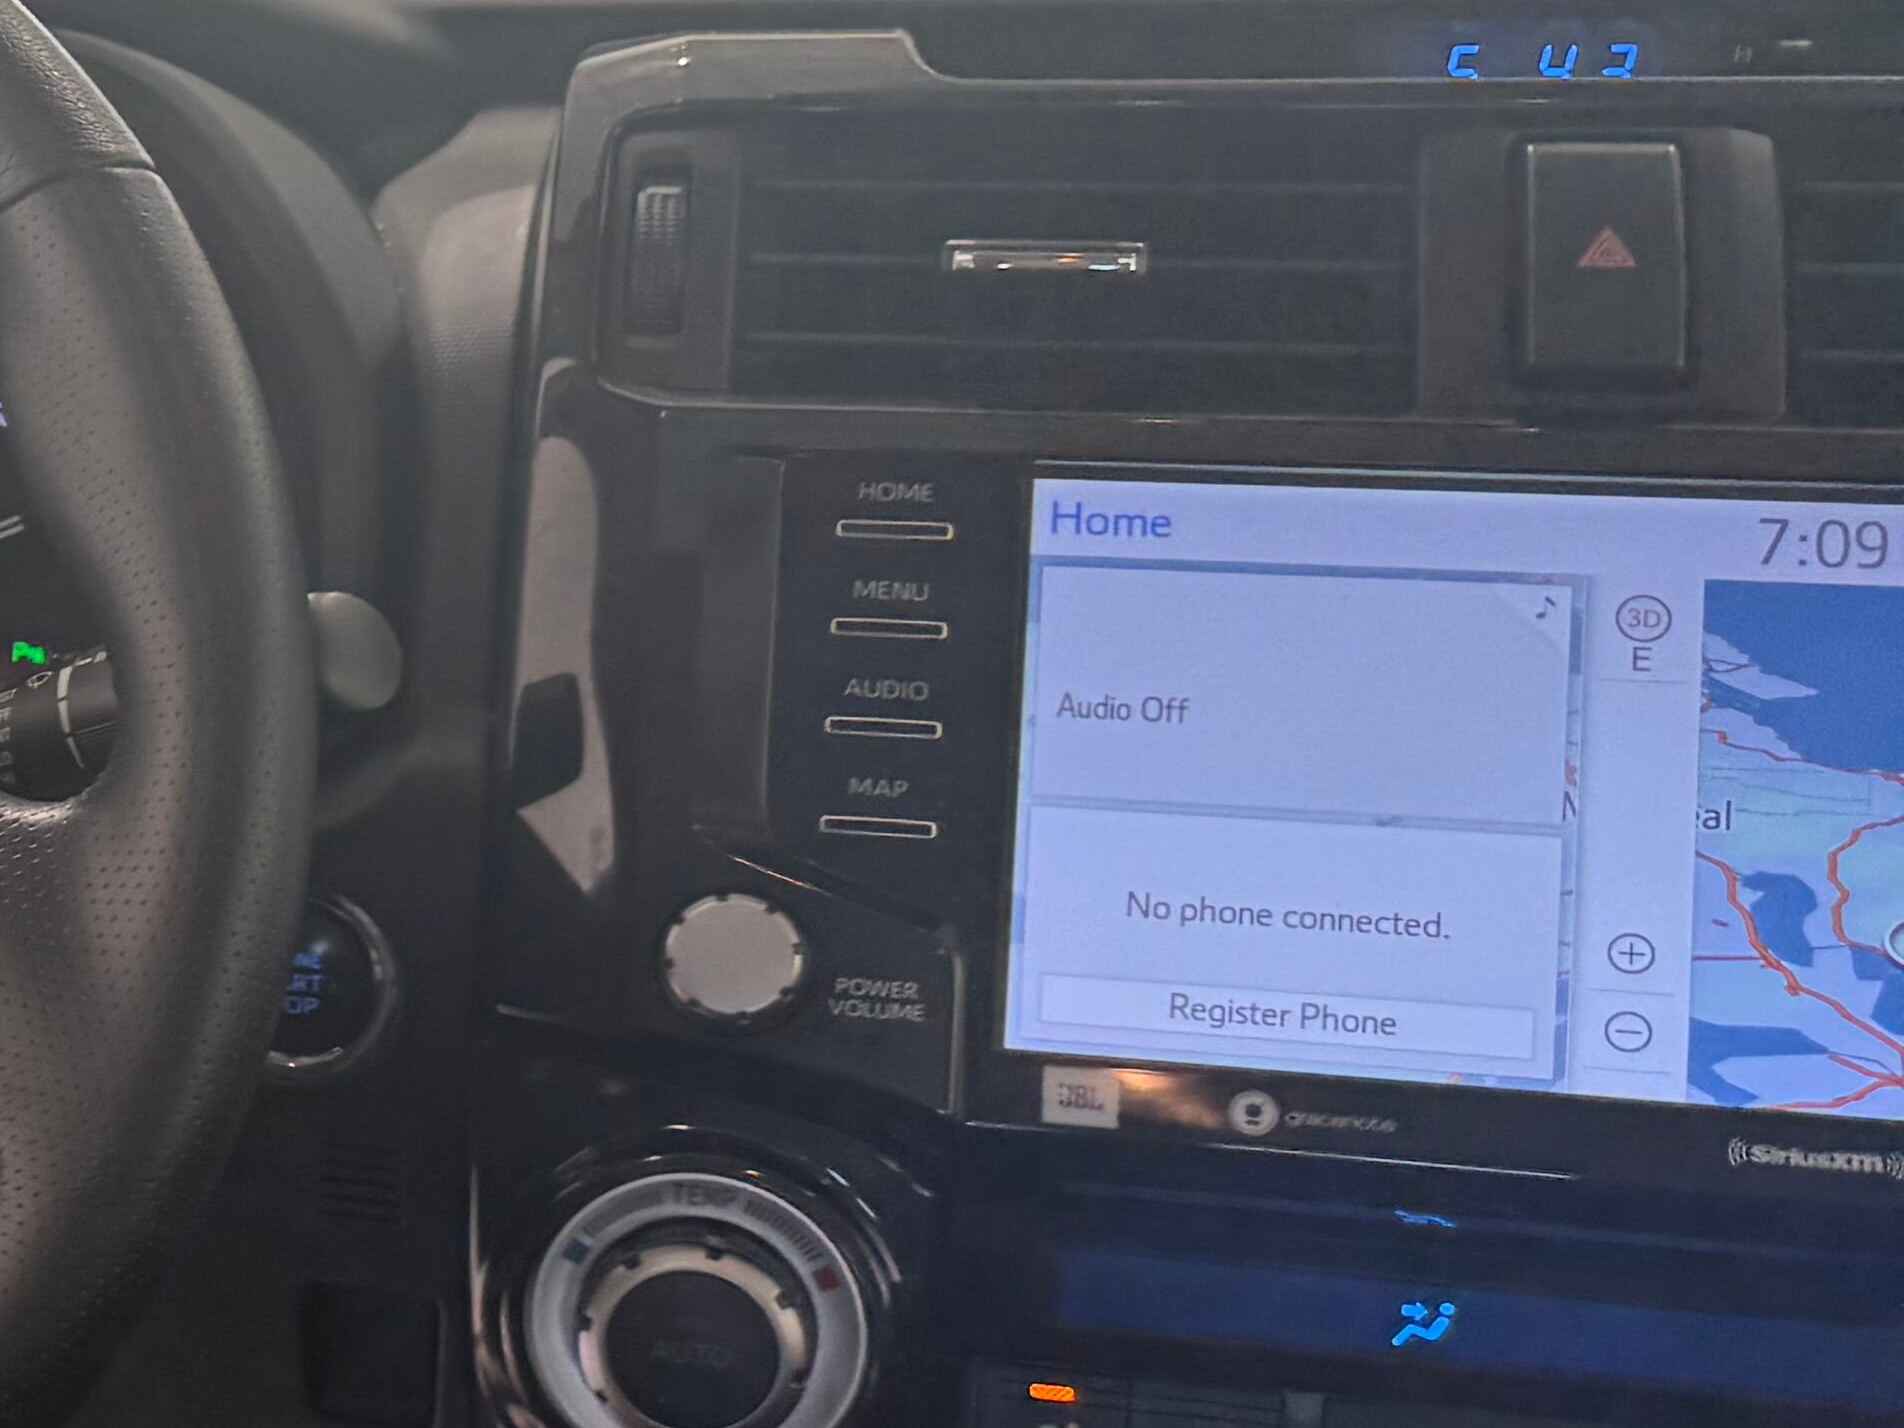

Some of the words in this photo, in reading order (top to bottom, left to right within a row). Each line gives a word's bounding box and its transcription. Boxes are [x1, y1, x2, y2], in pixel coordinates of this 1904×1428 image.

[857, 481, 935, 504] HOME
[1049, 500, 1173, 540] Home
[1757, 517, 1890, 570] 7:09
[852, 579, 930, 603] MENU
[1626, 607, 1662, 630] 3D
[1631, 645, 1654, 673] E
[843, 677, 930, 702] AUDIO
[1055, 690, 1132, 723] Audio
[1140, 695, 1191, 725] Off
[846, 777, 910, 799] MAP
[1695, 799, 1733, 832] al
[1125, 890, 1172, 921] No
[1179, 895, 1274, 930] phone
[1282, 904, 1451, 941] connected.
[833, 977, 920, 1001] POWER
[827, 998, 928, 1025] VOLUME
[1167, 991, 1293, 1031] Register
[1298, 1001, 1399, 1038] Phone
[1057, 1083, 1105, 1112] JBL
